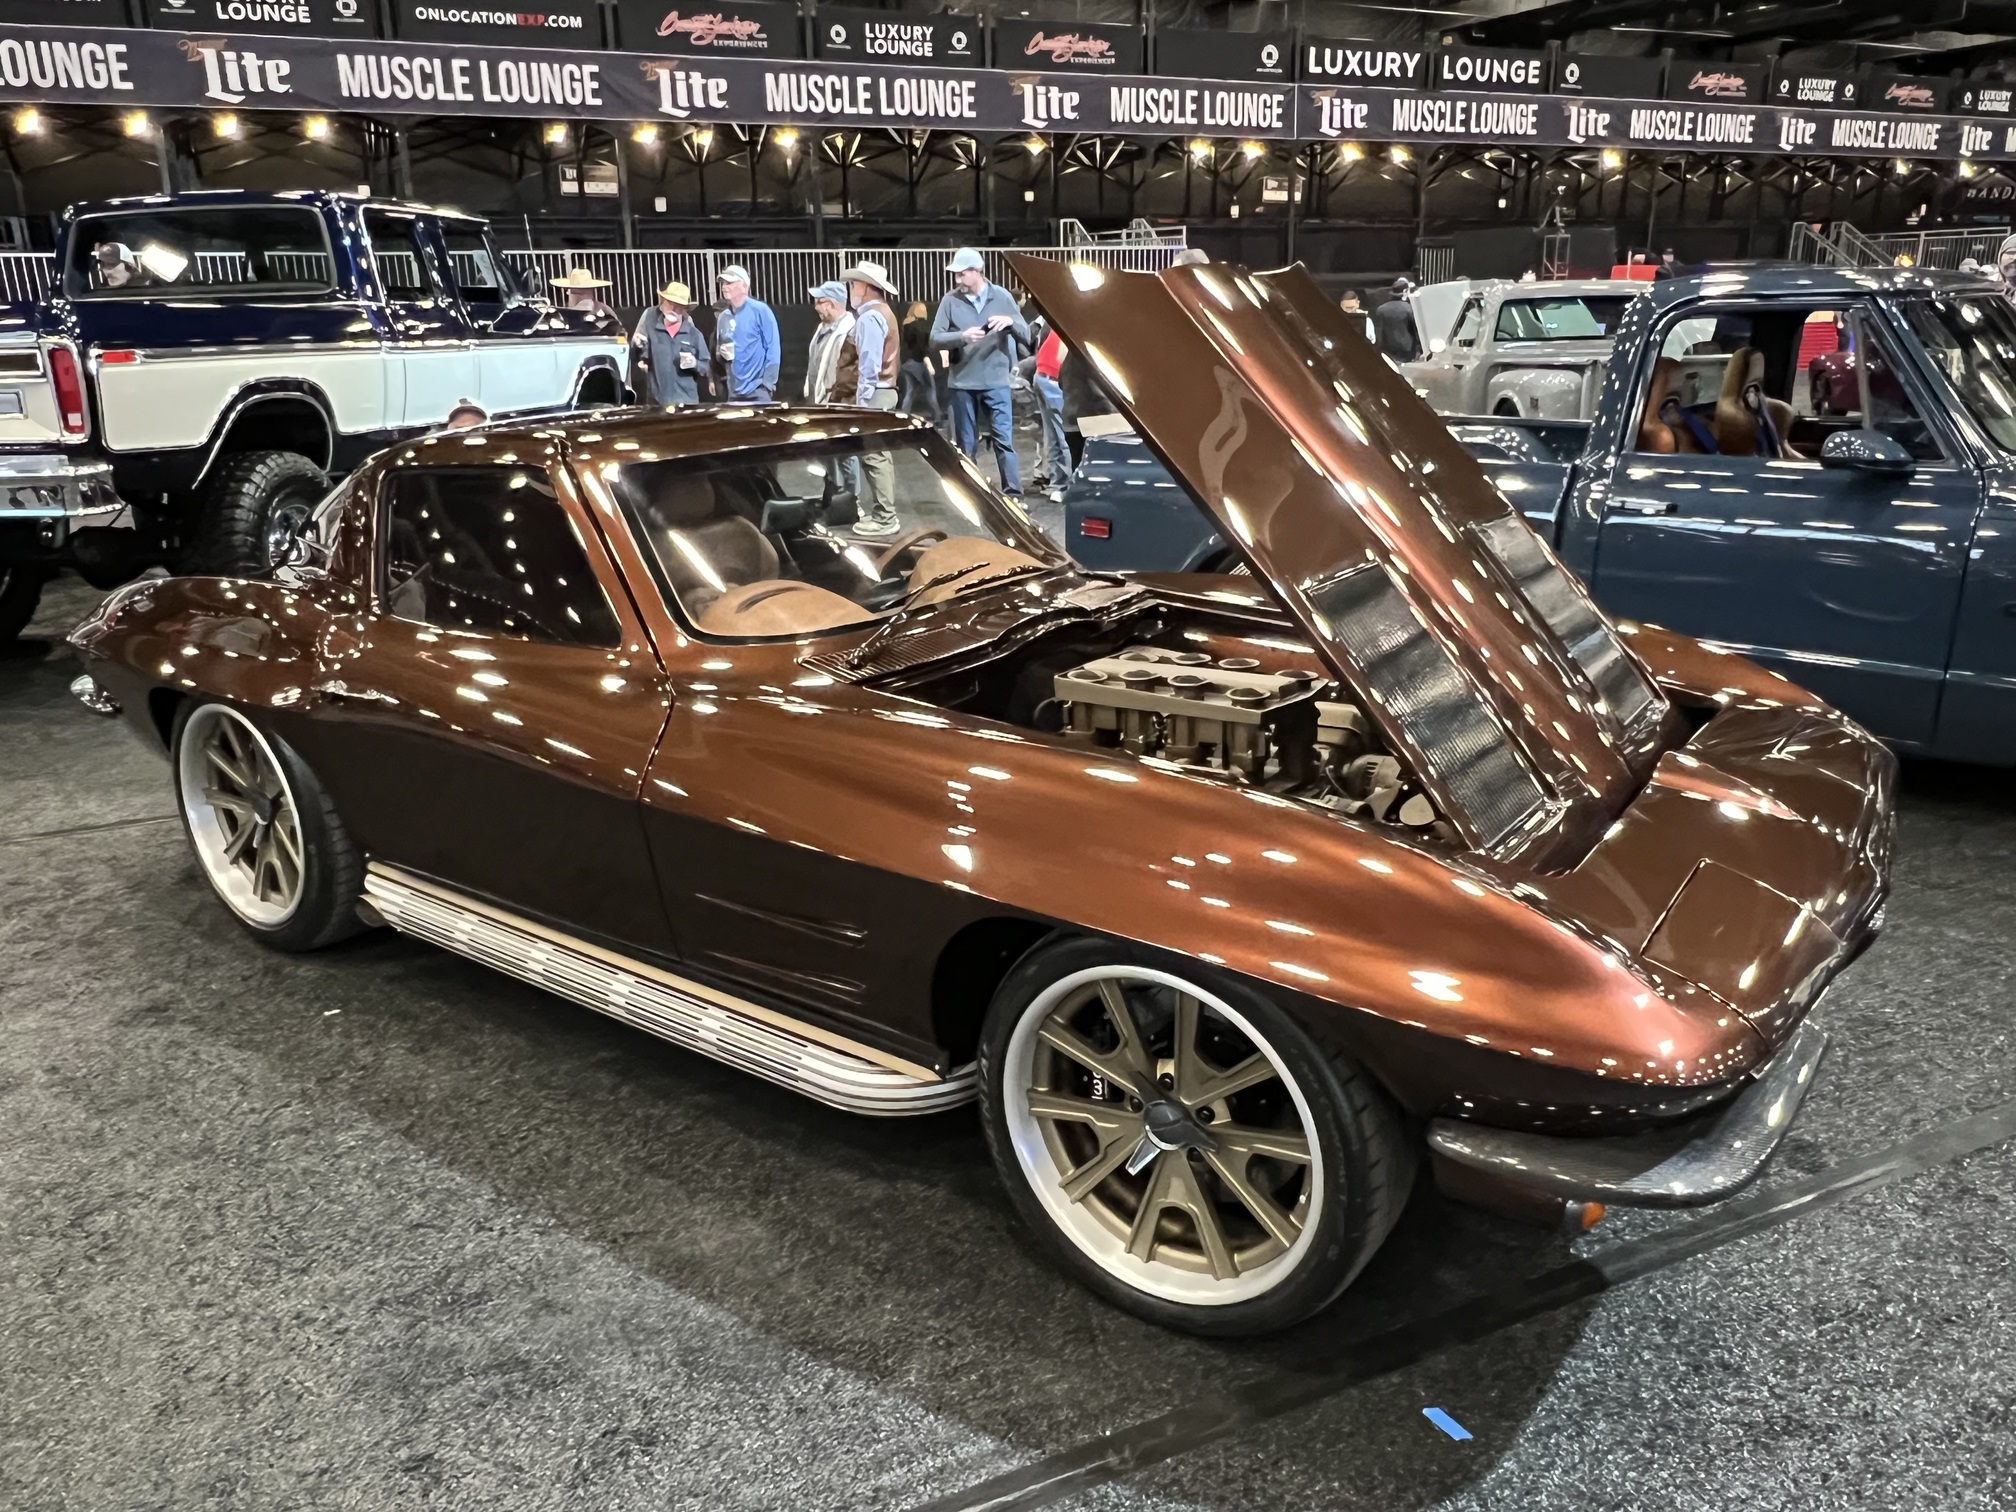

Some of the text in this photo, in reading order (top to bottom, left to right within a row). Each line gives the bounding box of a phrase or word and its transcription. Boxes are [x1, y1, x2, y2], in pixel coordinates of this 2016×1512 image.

[216, 2, 311, 23] LOUNGE
[415, 7, 582, 28] ONLOCATIONEXP.COM
[865, 23, 933, 41] LUXURY
[866, 39, 933, 57] LOUNGE
[0, 39, 134, 90] OUNGE
[336, 54, 474, 101] MUSCLE
[479, 60, 603, 106] LOUNGE
[1308, 46, 1541, 84] LUXURY LOUNGE
[655, 68, 729, 118] Lite
[764, 73, 873, 114] MUSCLE
[879, 77, 977, 118] LOUNGE
[1020, 84, 1080, 129] Lite
[1110, 87, 1198, 124] MUSCLE
[1203, 90, 1284, 128] LOUNGE
[1319, 96, 1368, 137] Lite
[1392, 98, 1539, 135] MUSCLE LOUNGE
[1567, 105, 1611, 144] Lite
[1630, 109, 1756, 143] MUSCLE LOUNGE
[1778, 116, 1816, 151] Lite
[1832, 118, 1941, 150] MUSCLE LOUNGE
